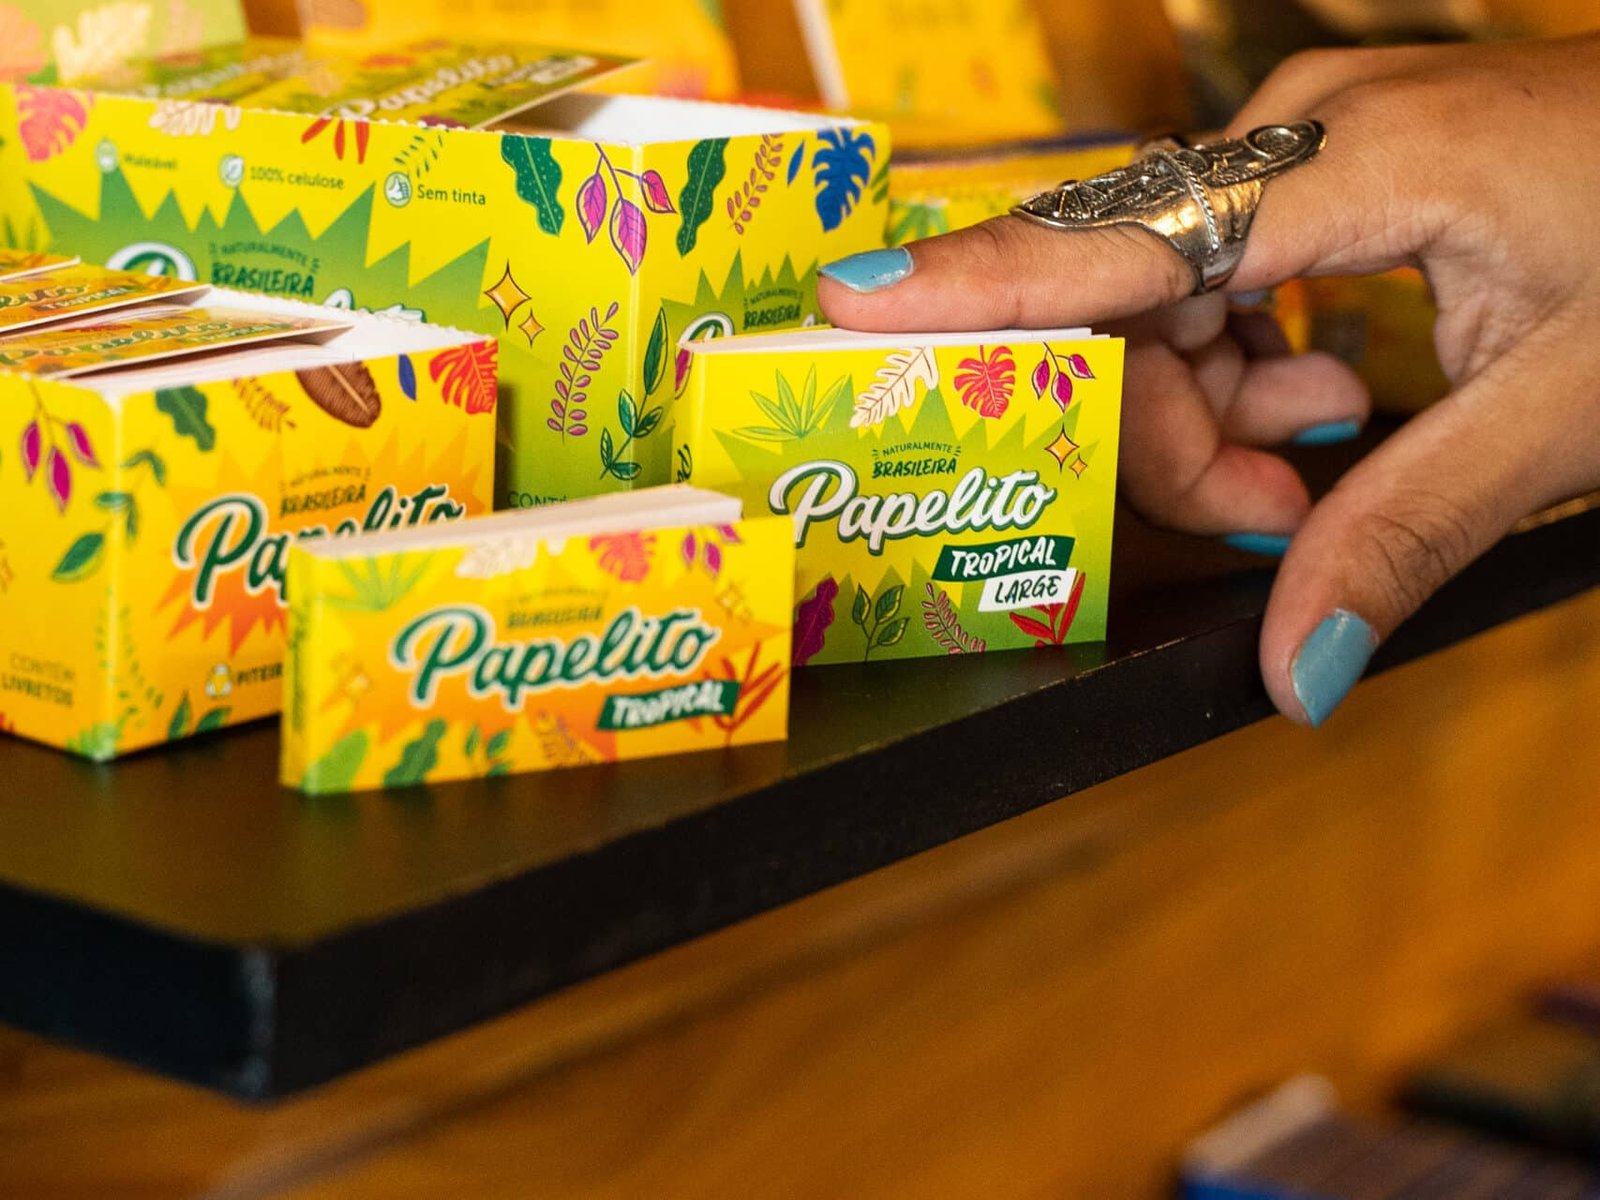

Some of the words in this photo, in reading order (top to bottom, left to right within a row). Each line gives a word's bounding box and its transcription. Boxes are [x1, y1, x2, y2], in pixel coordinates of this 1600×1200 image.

[250, 165, 284, 182] 100%
[287, 171, 345, 190] celulose
[417, 184, 449, 201] Sem
[452, 186, 487, 206] tinta
[212, 262, 314, 297] BRASILEIRA
[743, 304, 800, 330] BRASILEIRA
[883, 441, 952, 457] NATURALMENTE
[872, 456, 957, 479] BRASILEIRA
[279, 484, 367, 518] BRASILEIRA
[768, 459, 1057, 556] Papelito
[951, 536, 1057, 578] TROPICAL
[994, 575, 1061, 604] LARGE
[389, 603, 721, 710] Papelito
[237, 661, 284, 686] PITEIR
[612, 681, 725, 727] TROPICAL
